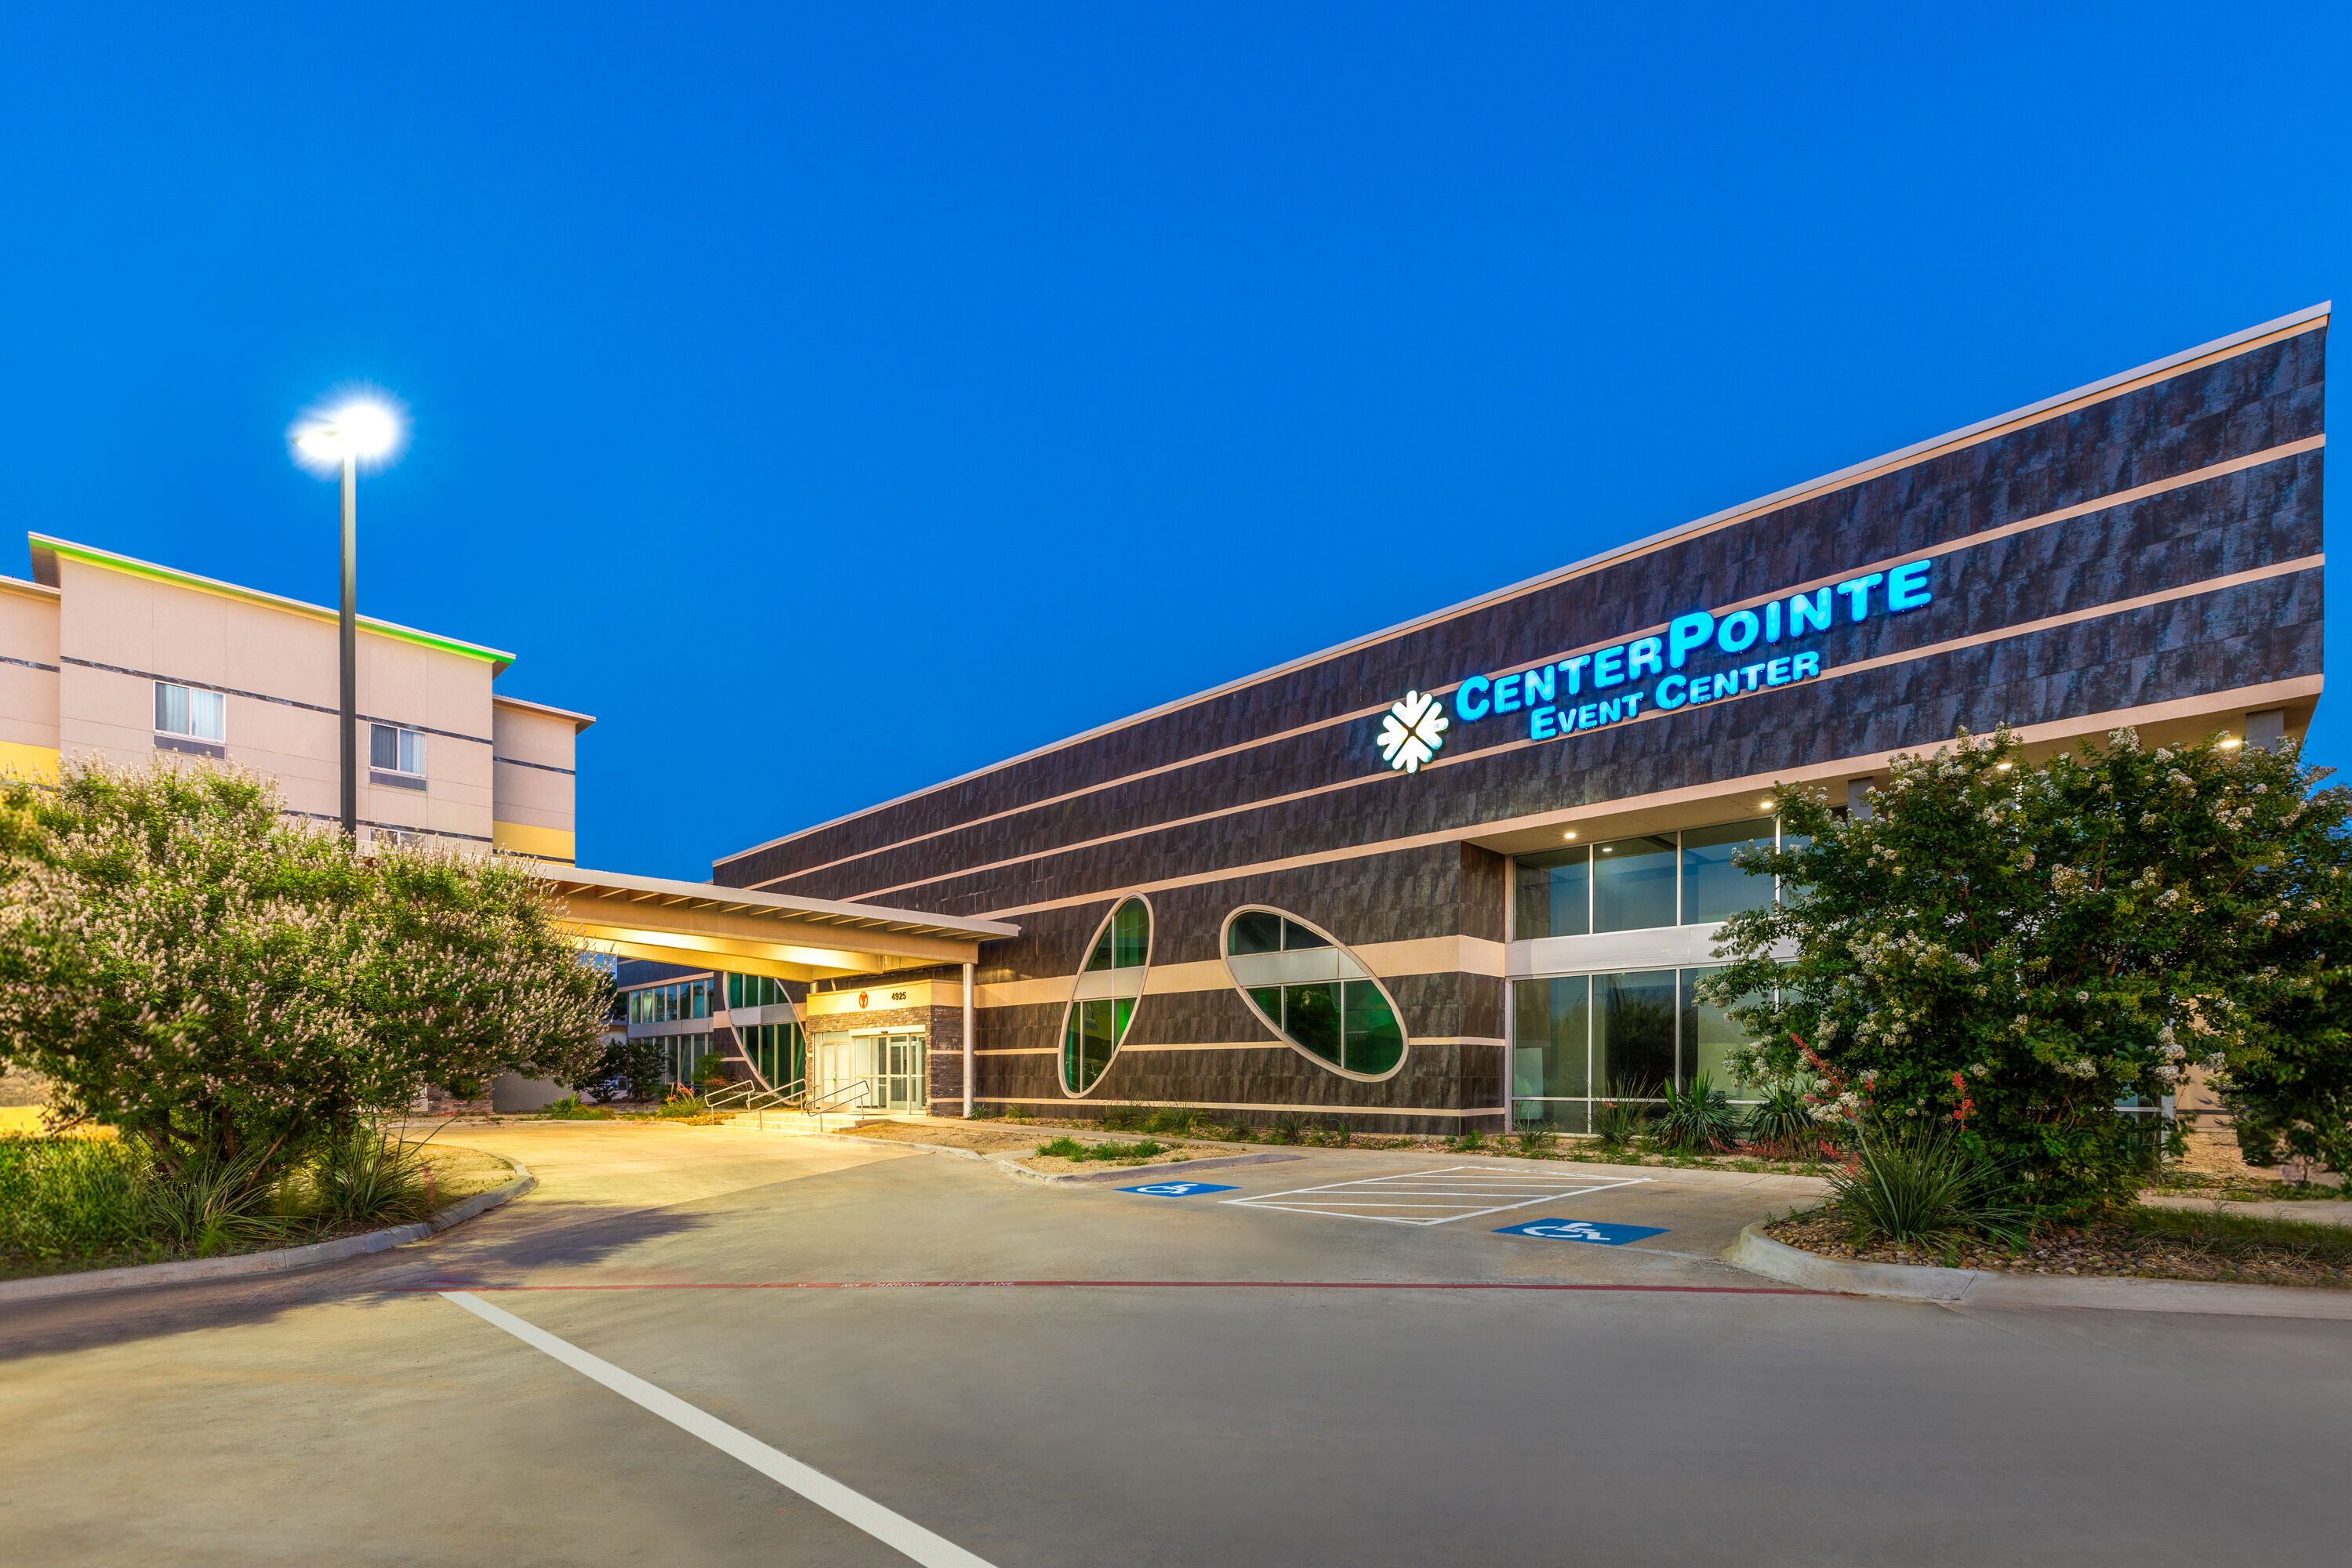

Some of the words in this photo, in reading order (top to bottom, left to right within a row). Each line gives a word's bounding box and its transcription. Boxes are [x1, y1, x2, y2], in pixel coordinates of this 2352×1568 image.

[1530, 691, 1645, 741] EVENT
[1654, 650, 1820, 710] CENTER
[891, 992, 906, 1000] 4925
